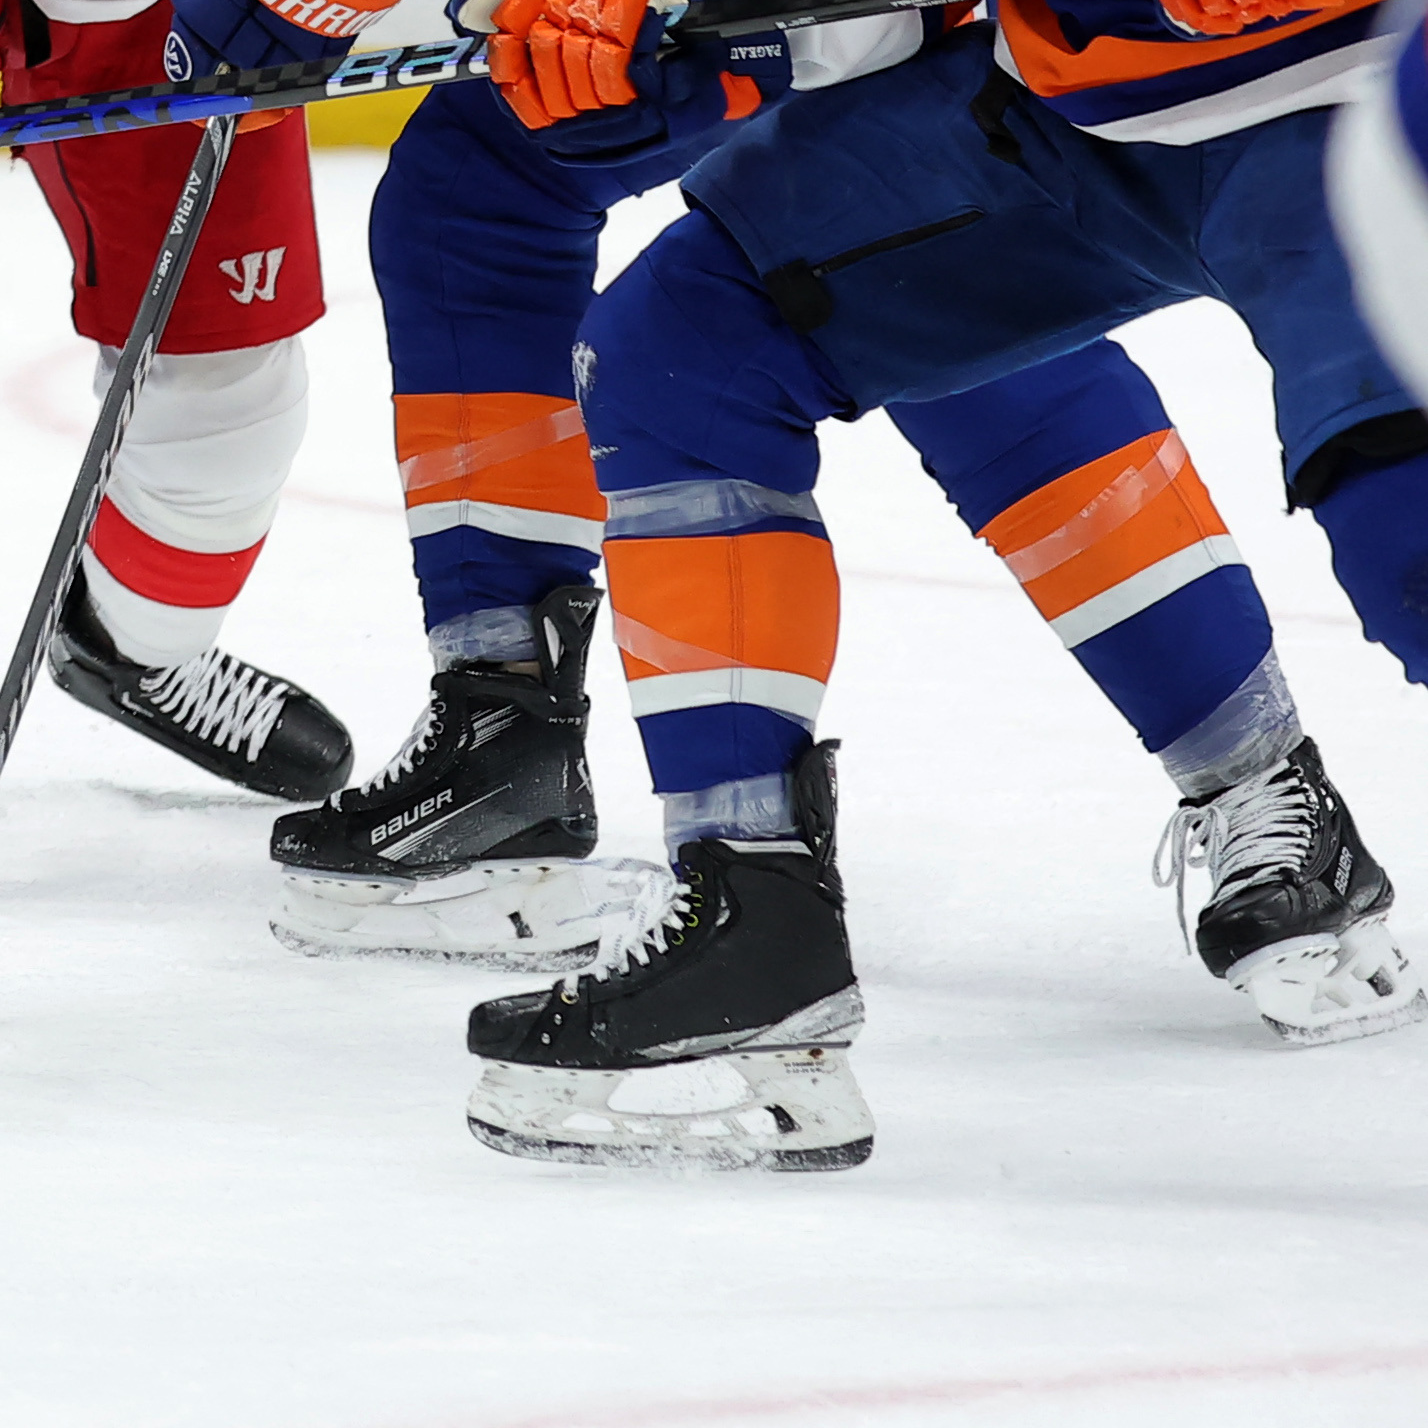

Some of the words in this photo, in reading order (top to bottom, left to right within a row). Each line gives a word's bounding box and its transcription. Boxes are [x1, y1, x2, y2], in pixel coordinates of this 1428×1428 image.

[728, 43, 783, 61] PAGEAU
[169, 169, 202, 236] ALPHA
[370, 787, 454, 847] BAUER
[1333, 845, 1354, 897] BAUER
